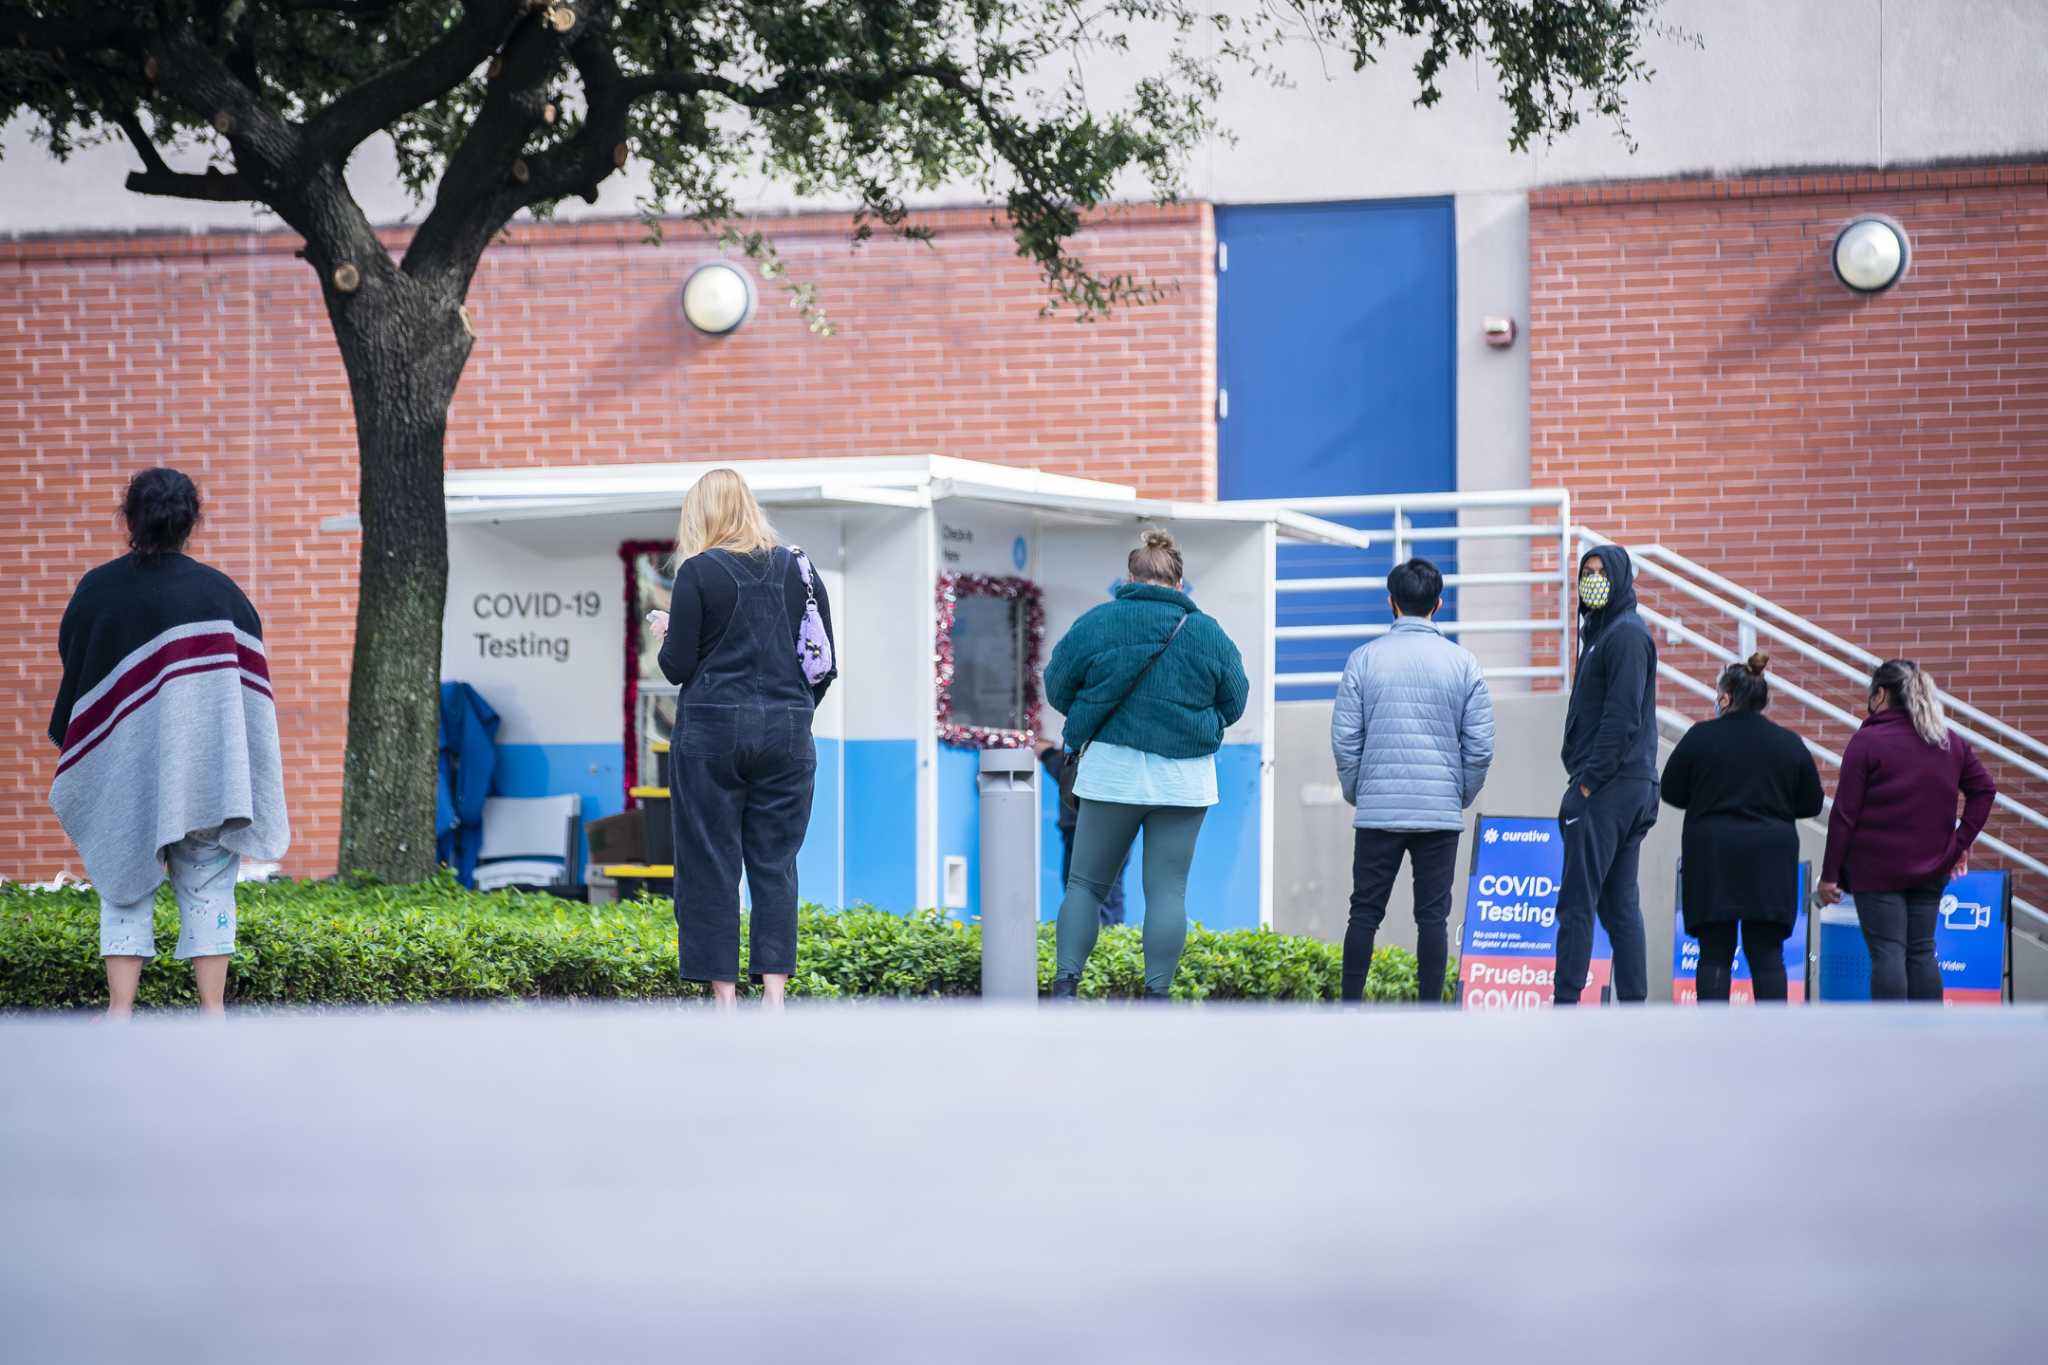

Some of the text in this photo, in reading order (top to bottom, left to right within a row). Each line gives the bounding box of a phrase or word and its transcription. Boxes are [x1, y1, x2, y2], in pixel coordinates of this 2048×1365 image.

[473, 591, 601, 619] COVID-19
[473, 632, 570, 663] Testing
[1502, 830, 1550, 843] curative
[1478, 875, 1561, 897] COVID-
[1476, 901, 1556, 928] Testing
[1467, 989, 1555, 1009] COVID-
